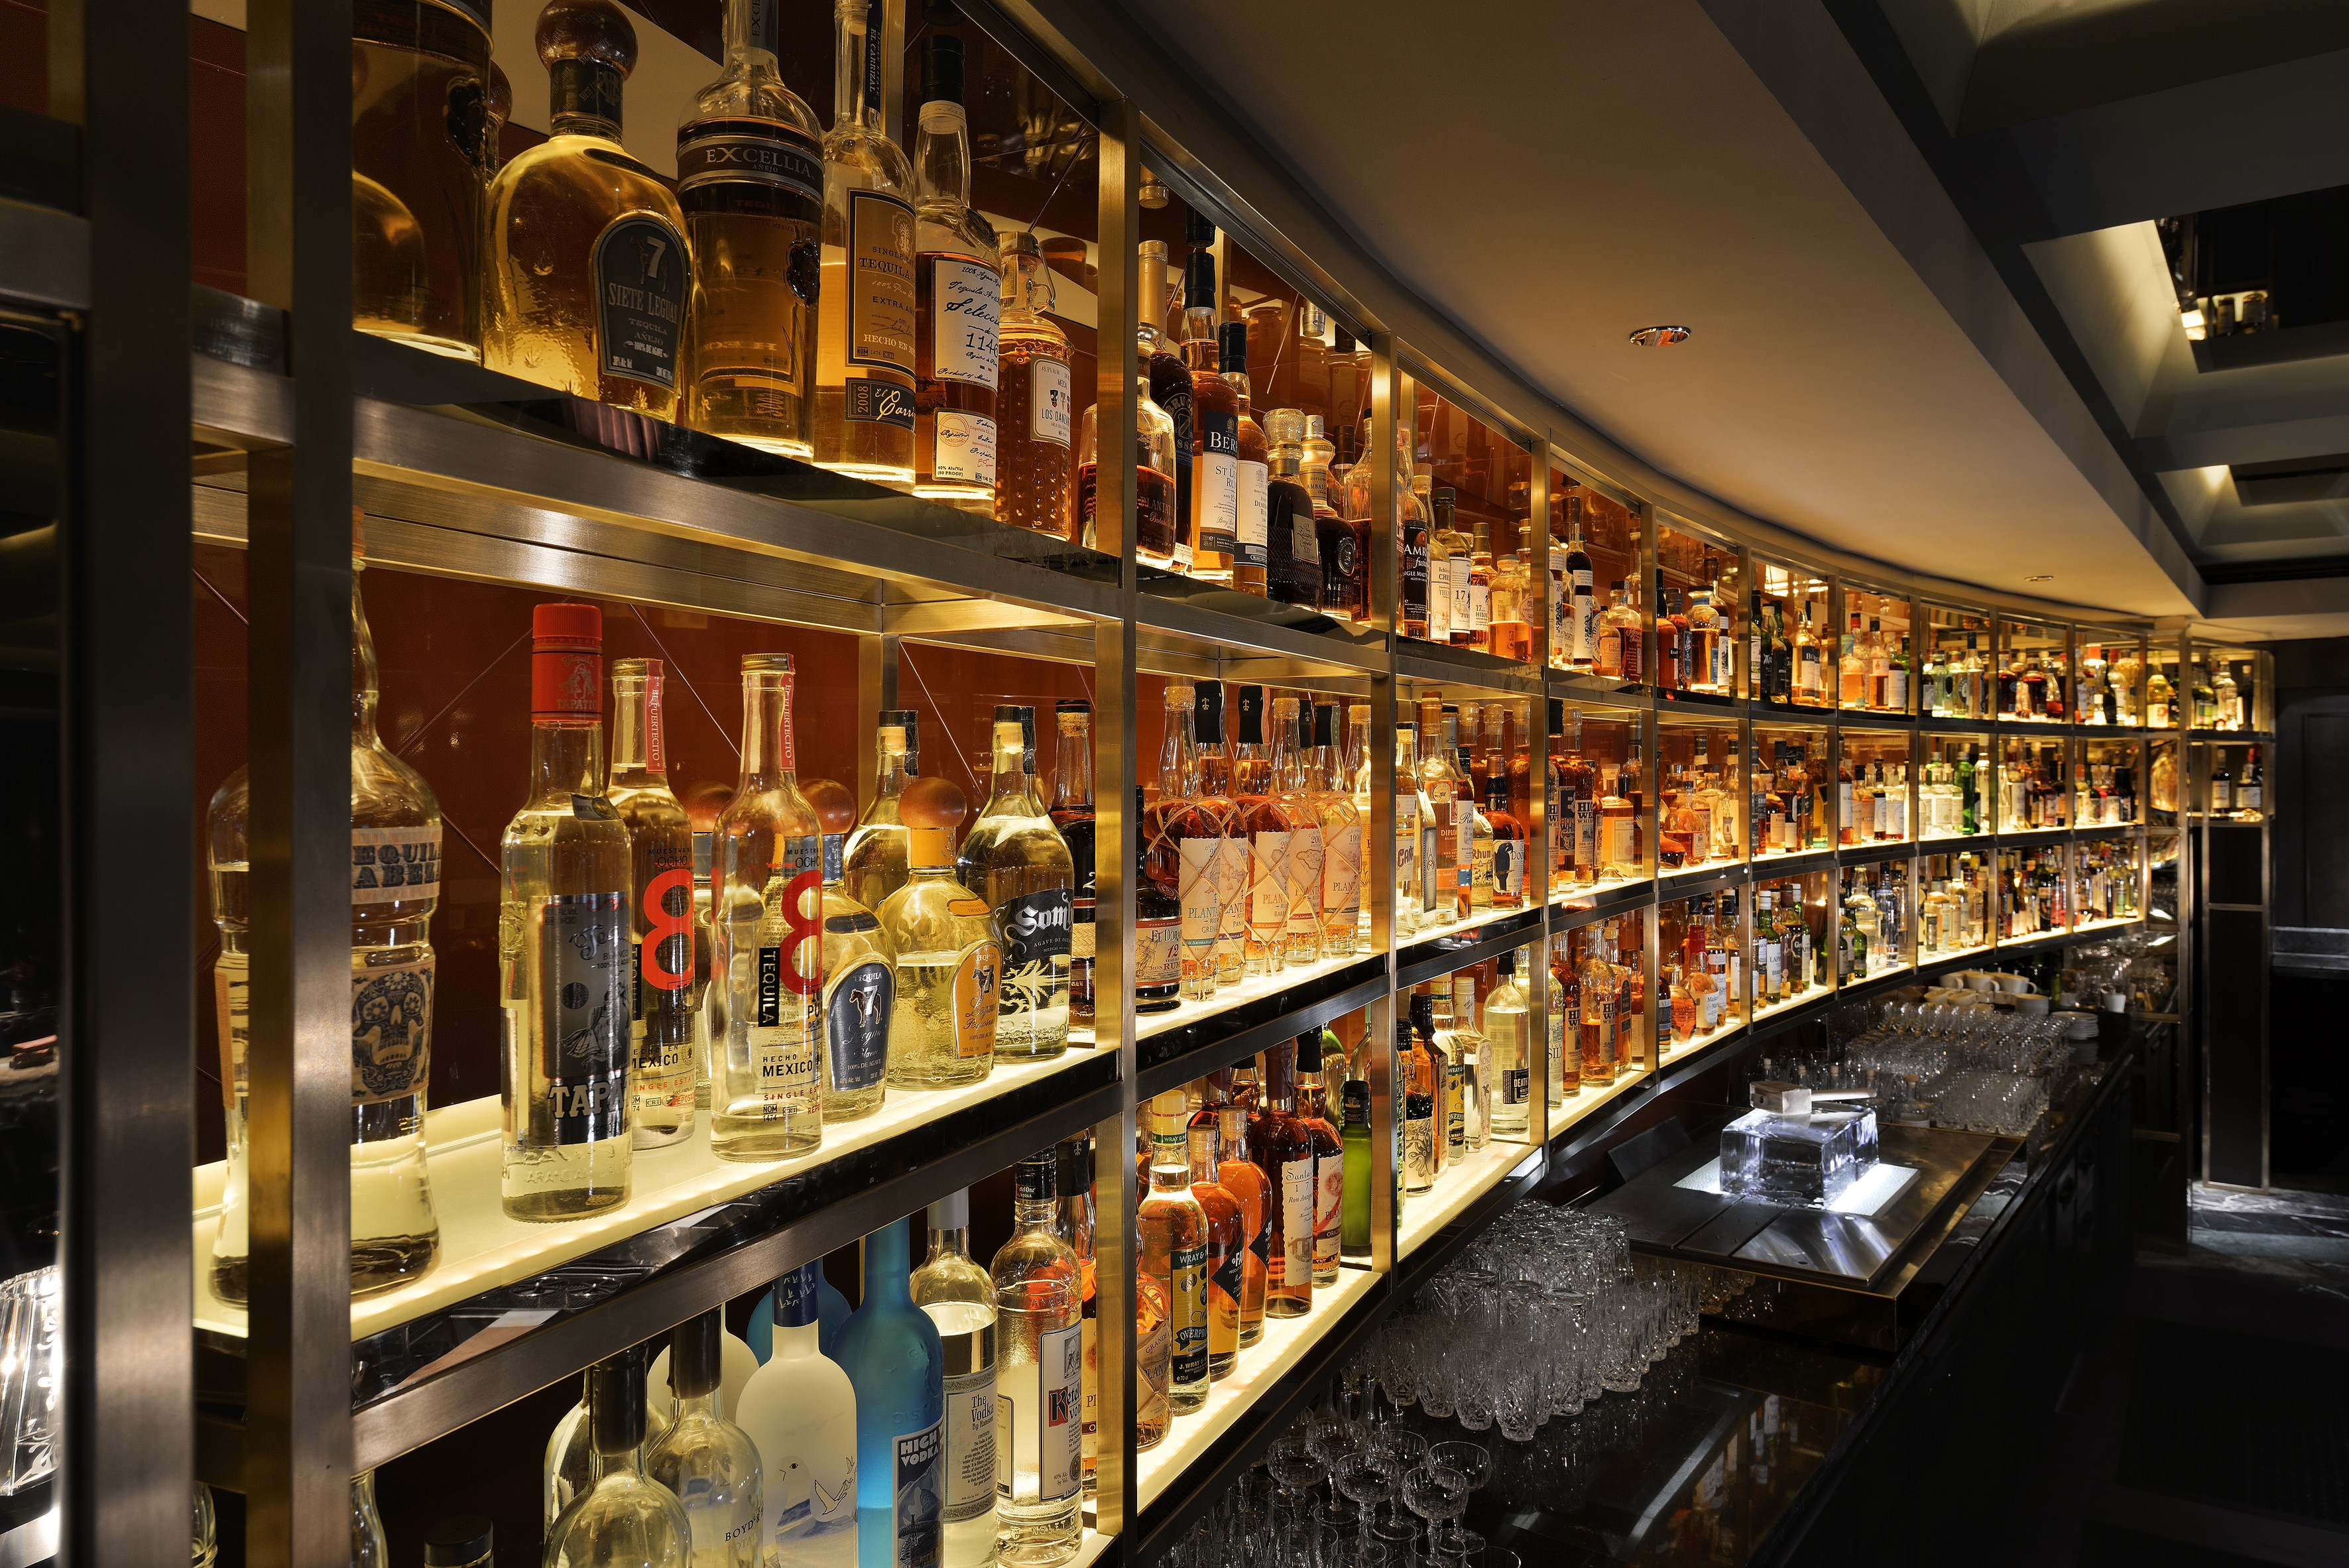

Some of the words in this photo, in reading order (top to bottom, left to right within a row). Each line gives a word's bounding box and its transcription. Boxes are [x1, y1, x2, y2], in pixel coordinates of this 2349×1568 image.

[705, 147, 812, 180] EXCELLIA
[752, 163, 779, 173] AÑEJO
[646, 235, 666, 279] 7
[872, 245, 904, 261] SINGLE
[859, 257, 911, 280] TEQUILA
[947, 280, 983, 294] Tequila
[607, 282, 644, 312] SIETE
[646, 292, 678, 325] LEGUAS
[873, 296, 904, 310] EXTRA
[629, 318, 668, 335] TEQUILA
[634, 331, 664, 346] AÑEJO
[863, 333, 896, 347] HECHO
[898, 340, 909, 351] EN
[965, 332, 998, 359] 1146
[857, 347, 869, 357] NOM
[857, 385, 869, 414] 2008
[1041, 408, 1053, 420] LOS
[1215, 465, 1228, 475] ST
[1455, 589, 1466, 600] 17
[556, 698, 598, 711] TAPATIO
[650, 701, 660, 761] PUERTECITO
[783, 697, 792, 759] PUERTECITO
[353, 842, 442, 866] EQUIL
[656, 855, 688, 868] OCHO
[1472, 849, 1492, 860] Rhum
[795, 856, 821, 869] OCHO
[641, 868, 694, 991] 8
[780, 869, 822, 995] 8
[1034, 937, 1054, 948] AGAVE
[1167, 943, 1179, 959] 12
[1164, 961, 1181, 970] RUM
[762, 950, 776, 1024] TEQUILA
[983, 964, 994, 994] 7
[863, 985, 879, 1017] 7
[762, 1054, 797, 1063] HECHO
[762, 1059, 813, 1077] MEXICO
[764, 1089, 805, 1101] SINGLE
[1286, 1167, 1310, 1181] Santa
[1179, 1252, 1201, 1264] WRAY
[1184, 1359, 1201, 1370] WRAY
[971, 1393, 987, 1409] The
[1050, 1385, 1081, 1423] Ketel
[971, 1402, 994, 1423] Vodka
[972, 1422, 979, 1431] By
[979, 1416, 994, 1427] Ransom
[900, 1429, 937, 1456] HIGH
[900, 1444, 939, 1467] VODKA
[725, 1519, 754, 1543] BOYD
